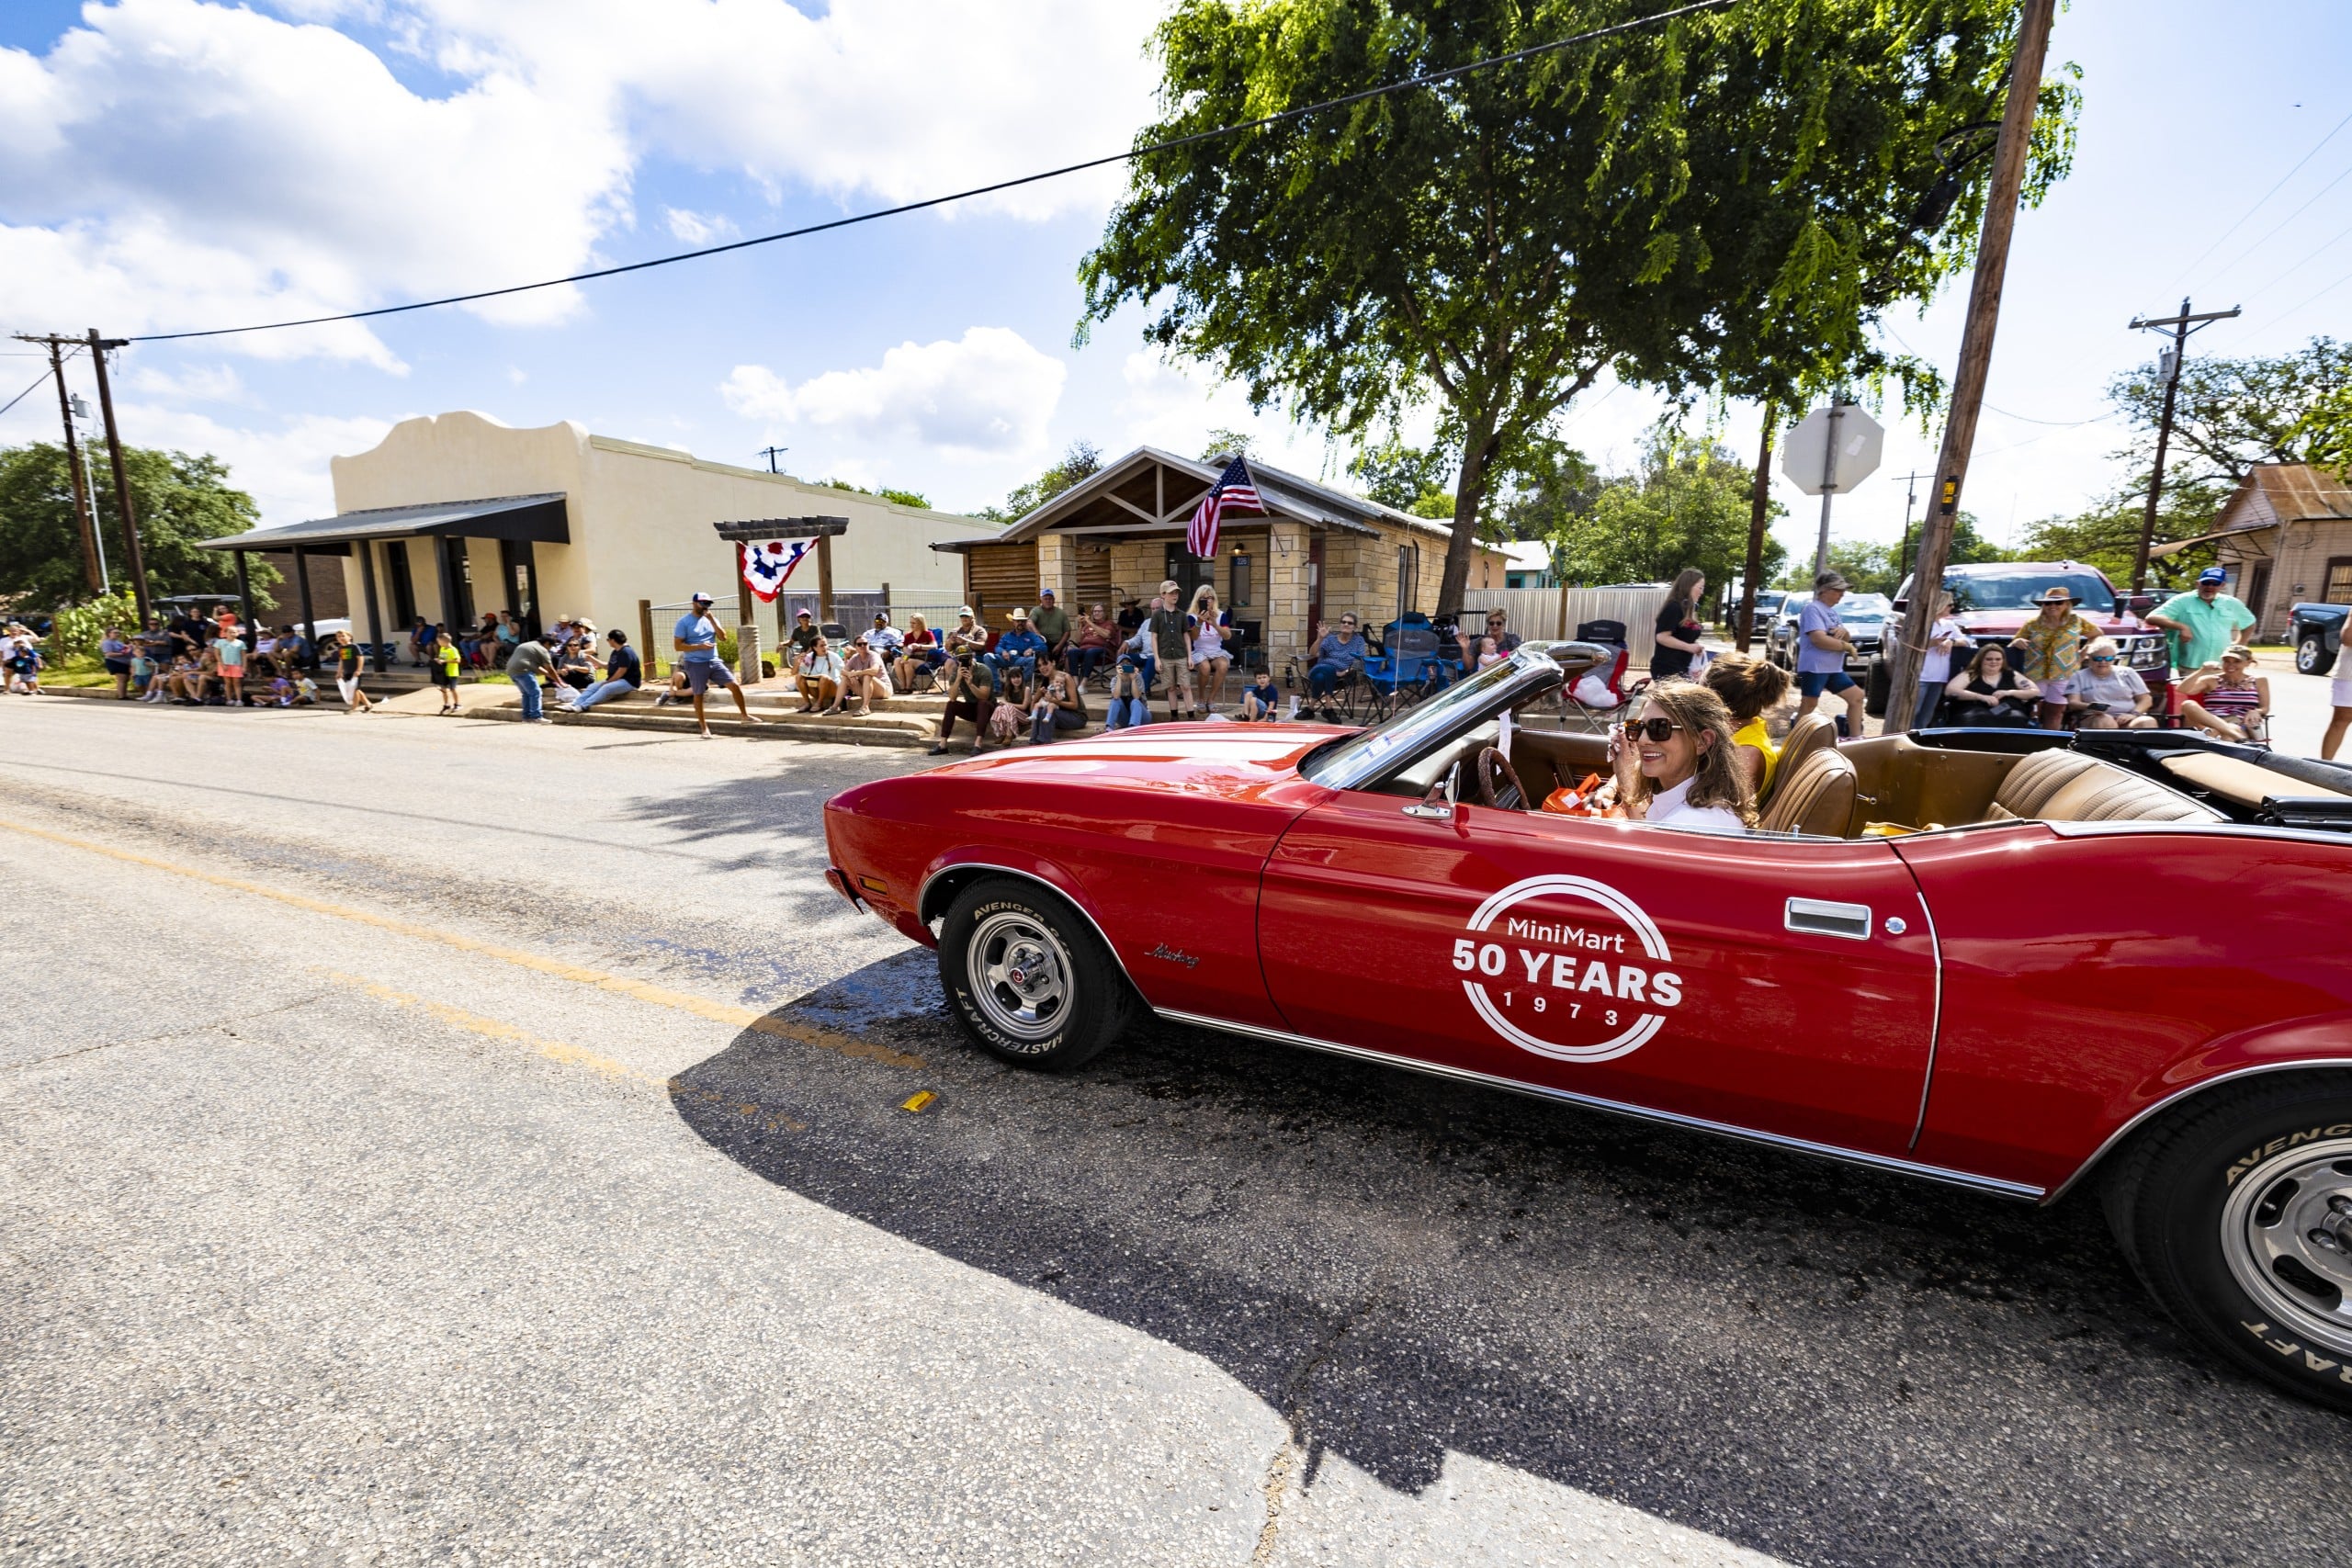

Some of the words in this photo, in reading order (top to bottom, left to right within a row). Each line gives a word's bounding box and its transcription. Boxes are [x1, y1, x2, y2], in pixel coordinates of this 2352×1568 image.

[974, 902, 1044, 923] AVENGER
[1508, 917, 1625, 953] MiniMart
[1453, 938, 1507, 976] 50
[1518, 948, 1683, 1007] YEARS
[956, 987, 1063, 1054] MASTERCRAFT
